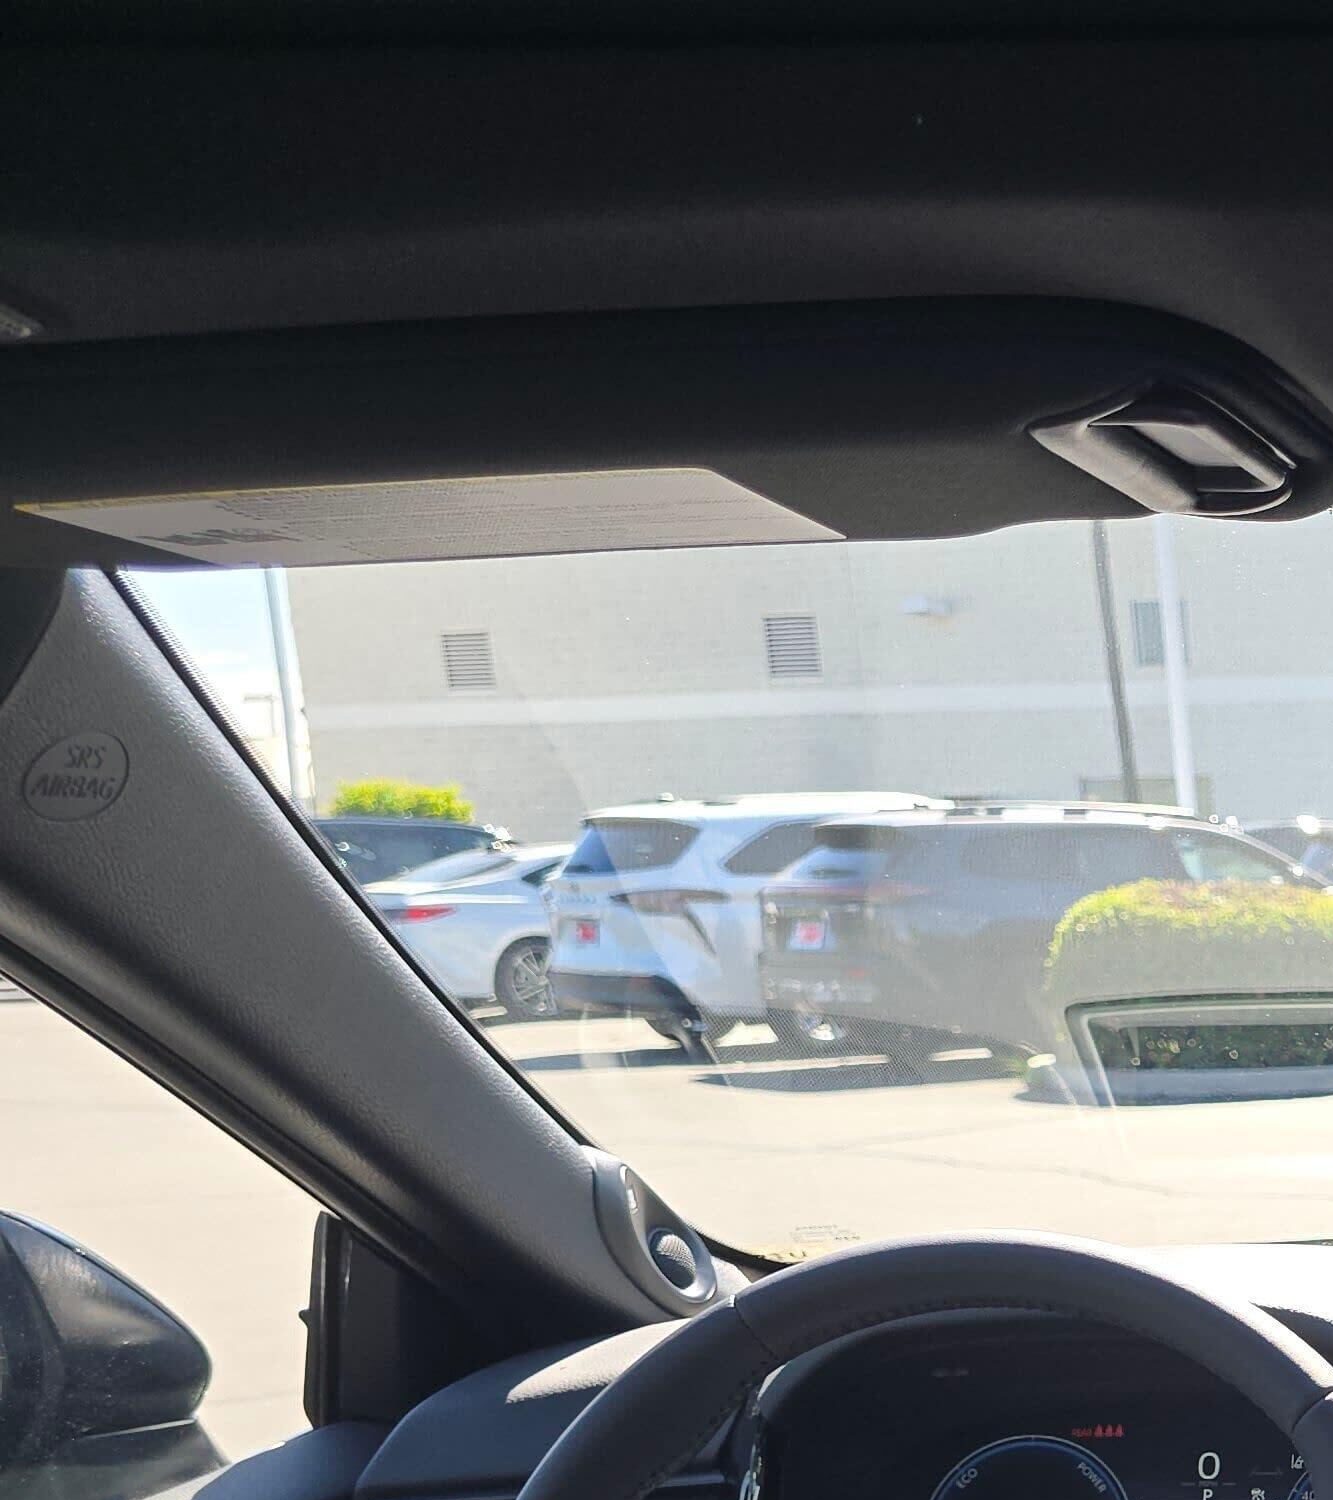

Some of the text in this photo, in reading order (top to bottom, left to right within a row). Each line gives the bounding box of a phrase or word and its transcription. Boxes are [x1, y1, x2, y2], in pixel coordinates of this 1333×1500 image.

[64, 744, 106, 768] SRS
[31, 773, 116, 800] AIRBAG
[956, 1467, 978, 1489] ECO
[1077, 1462, 1107, 1493] POWER
[1198, 1451, 1221, 1480] 0
